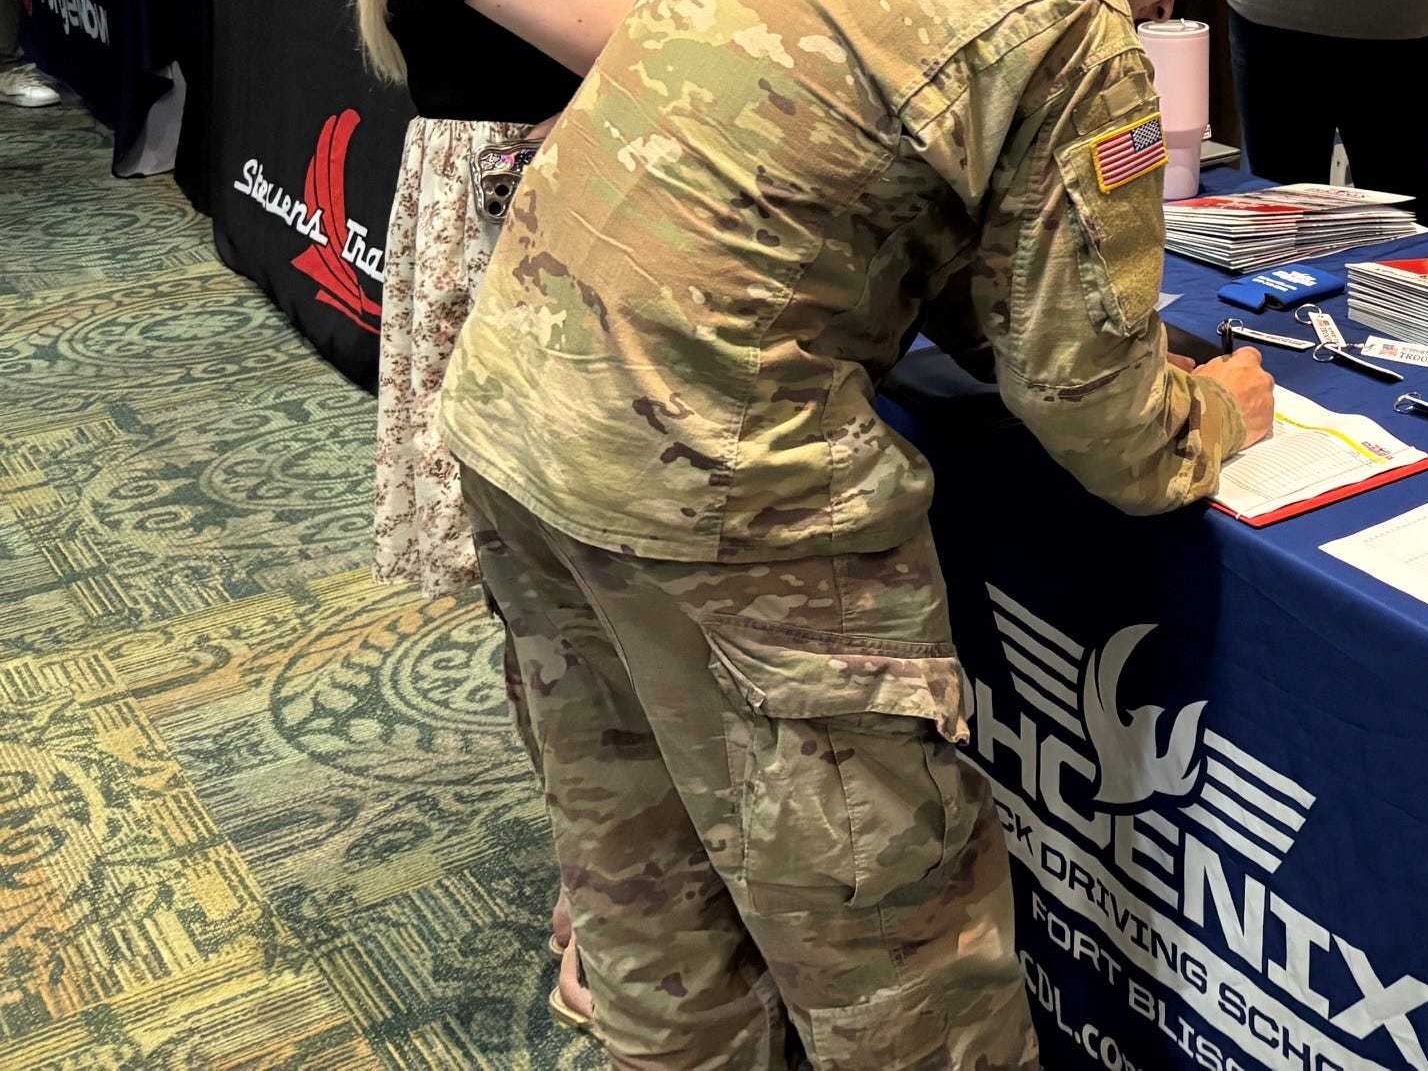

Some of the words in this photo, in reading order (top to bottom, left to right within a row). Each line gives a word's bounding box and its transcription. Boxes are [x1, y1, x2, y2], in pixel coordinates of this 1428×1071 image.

[234, 158, 328, 246] Stevens
[1032, 891, 1121, 985] FORT
[1041, 841, 1207, 995] DRIVING
